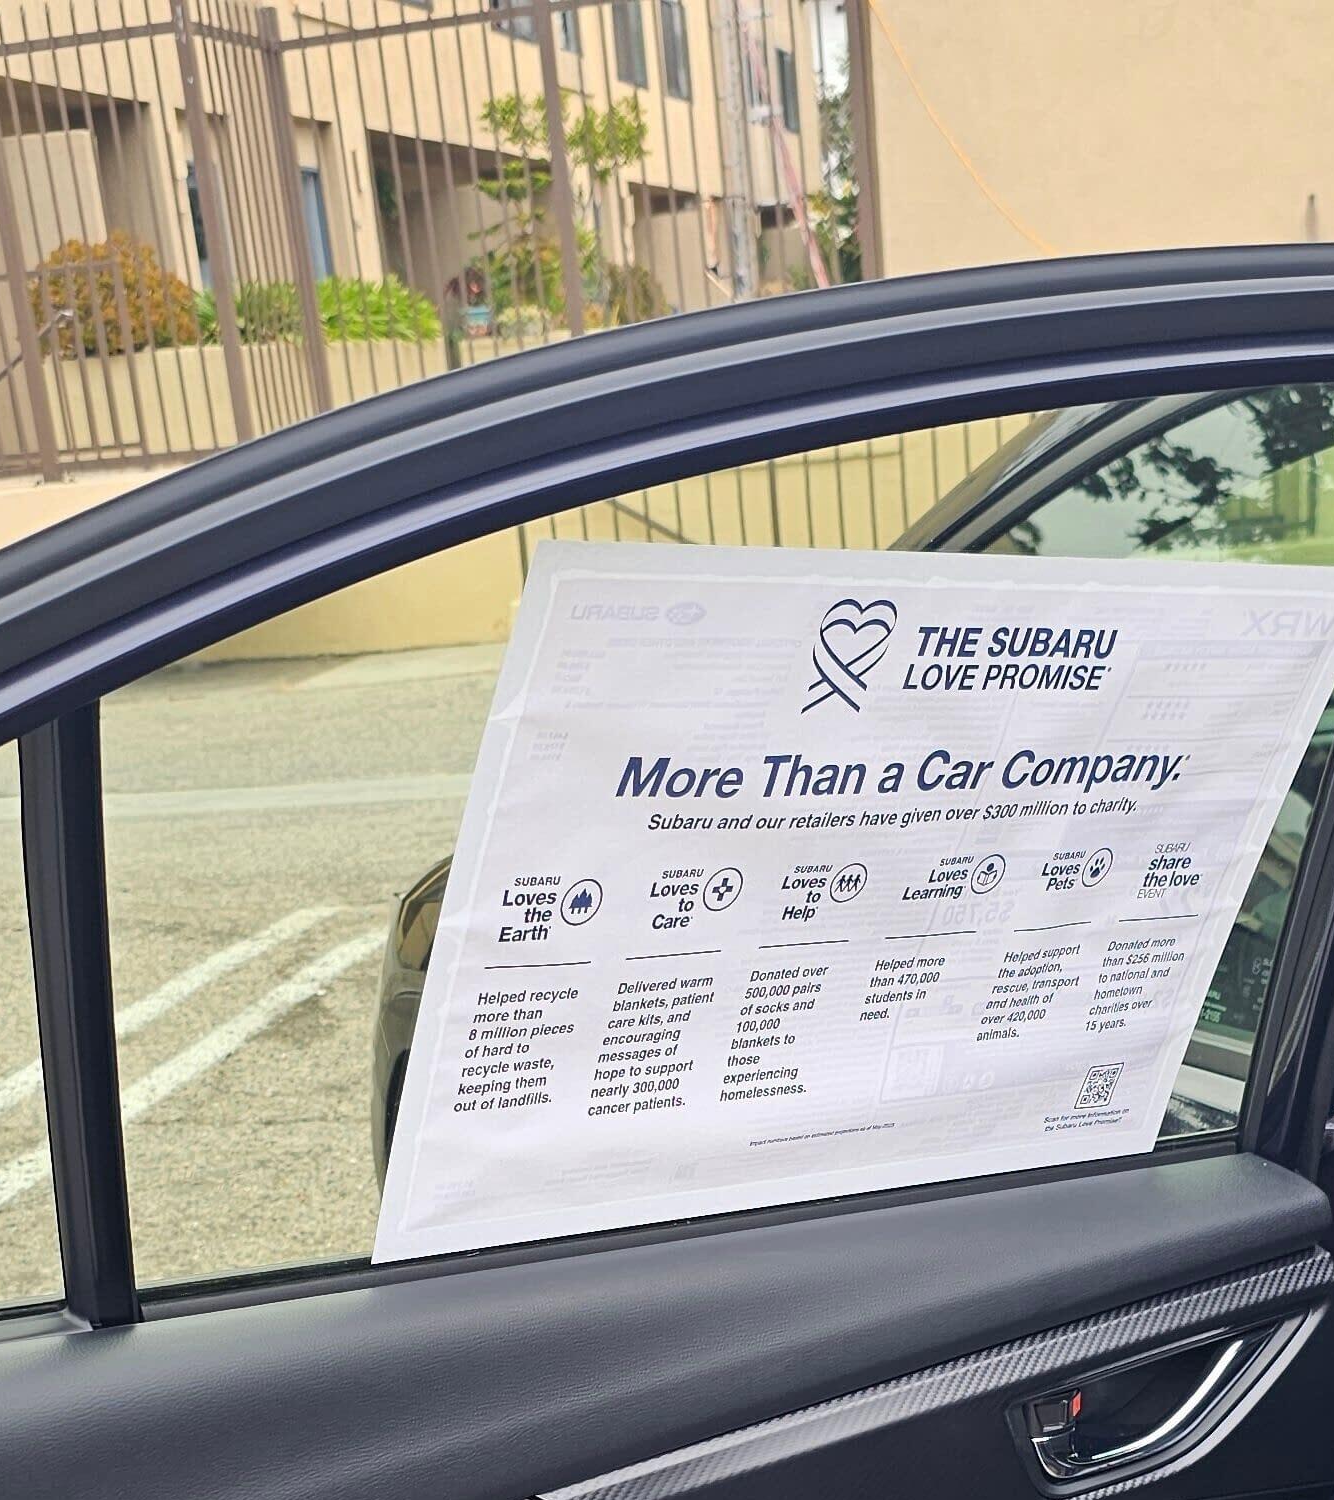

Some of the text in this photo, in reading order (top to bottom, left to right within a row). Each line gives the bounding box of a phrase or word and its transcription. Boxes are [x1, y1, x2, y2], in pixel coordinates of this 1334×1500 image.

[917, 626, 1118, 659] THE SUBARU
[902, 663, 1107, 691] LOVE PROMISE
[615, 749, 1184, 798] More Than a Car Company.
[648, 797, 1137, 830] Subaru and our retailers have given over $300 million to charity.
[940, 856, 974, 866] SUBARU
[1053, 850, 1086, 861] SUBARU
[1148, 855, 1191, 871] share
[662, 869, 704, 879] SUBARU
[794, 865, 833, 873] SUBARU
[928, 869, 969, 883] Loves
[1041, 863, 1081, 876] Loves
[514, 876, 561, 886] SUBARU
[781, 876, 827, 890] Loves
[1046, 877, 1075, 891] Pets
[1143, 870, 1200, 887] the love
[502, 890, 557, 906] Loves
[650, 882, 699, 898] Loves
[806, 890, 821, 903] to
[902, 884, 963, 900] Learning
[678, 898, 694, 912] to
[524, 907, 552, 923] the
[782, 905, 816, 922] Help
[652, 914, 690, 930] Care
[498, 924, 548, 942] Earth
[1004, 944, 1080, 964] Helped support
[875, 957, 945, 973] Helped more
[998, 962, 1062, 978] the adoption,
[750, 966, 829, 982] Donated over
[870, 971, 940, 988] than 470,000
[617, 977, 713, 995] Delivered warm
[744, 982, 821, 999] 500,000 pairs
[992, 976, 1080, 994] rescue, transport
[477, 987, 578, 1007] Helped recycle
[612, 992, 714, 1012] blankets, patient
[864, 989, 926, 1004] students in
[986, 992, 1054, 1009] and health of
[740, 998, 815, 1016] of socks and
[859, 1008, 889, 1021] need.
[473, 1008, 543, 1024] more than
[608, 1010, 691, 1029] care kits, and
[981, 1009, 1046, 1025] over 420,000
[468, 1024, 574, 1041] 8 million pieces
[737, 1018, 780, 1033] 100,000
[603, 1029, 681, 1046] encouraging
[731, 1034, 795, 1050] blankets to
[976, 1027, 1019, 1041] animals.
[465, 1043, 530, 1059] of hard to
[597, 1044, 679, 1063] messages of
[461, 1058, 554, 1078] recycle waste,
[727, 1055, 760, 1067] those
[594, 1060, 693, 1082] hope to support
[723, 1066, 799, 1086] experiencing
[457, 1076, 547, 1096] keeping them
[591, 1077, 680, 1098] nearly 300,000
[719, 1084, 806, 1102] homelessness.
[453, 1091, 552, 1112] out of landfills.
[588, 1096, 685, 1116] cancer patients.
